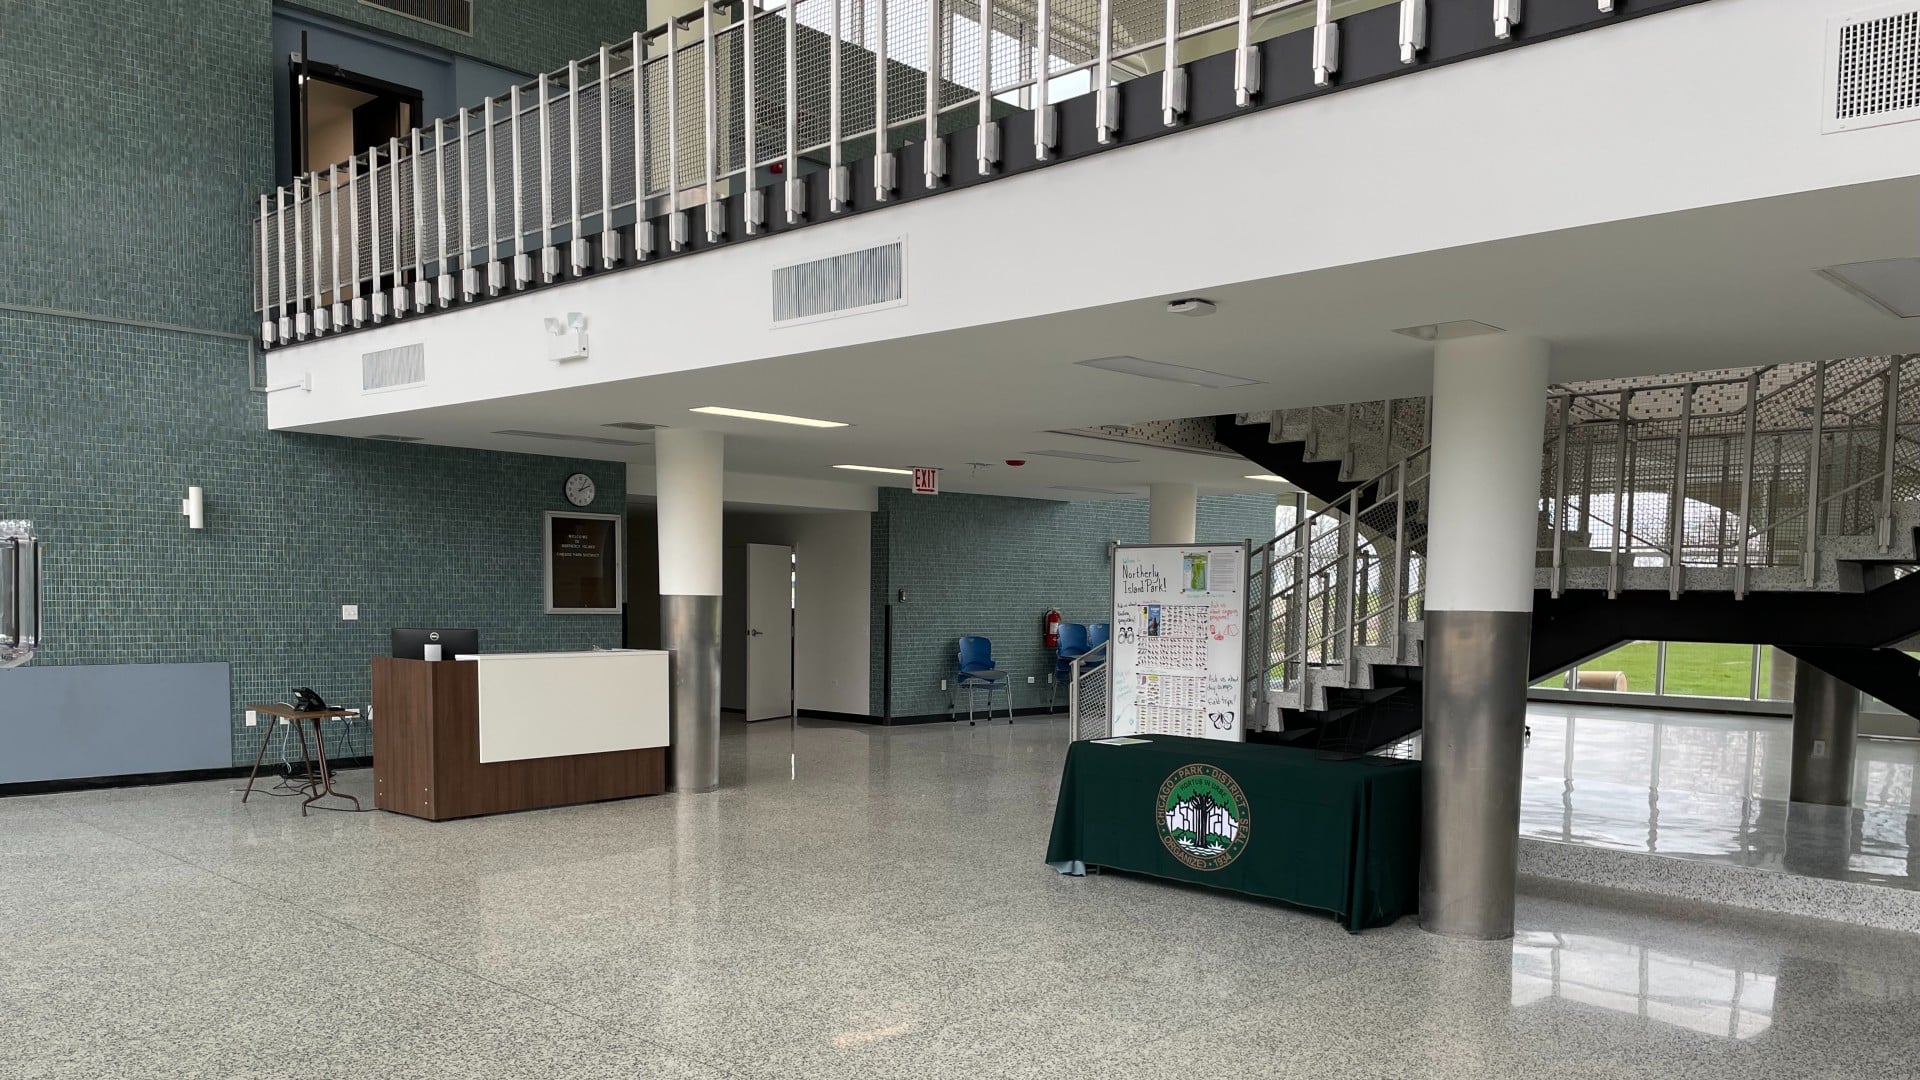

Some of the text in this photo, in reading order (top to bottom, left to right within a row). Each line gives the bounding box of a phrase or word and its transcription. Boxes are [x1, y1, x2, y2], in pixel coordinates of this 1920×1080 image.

[915, 468, 936, 488] EXIT
[1122, 563, 1159, 584] Northerly
[1122, 580, 1144, 594] Island
[1145, 577, 1167, 593] Park!
[1157, 766, 1249, 844] CHICAGO PARK DISTRICT SEAL
[1214, 852, 1232, 867] 1934
